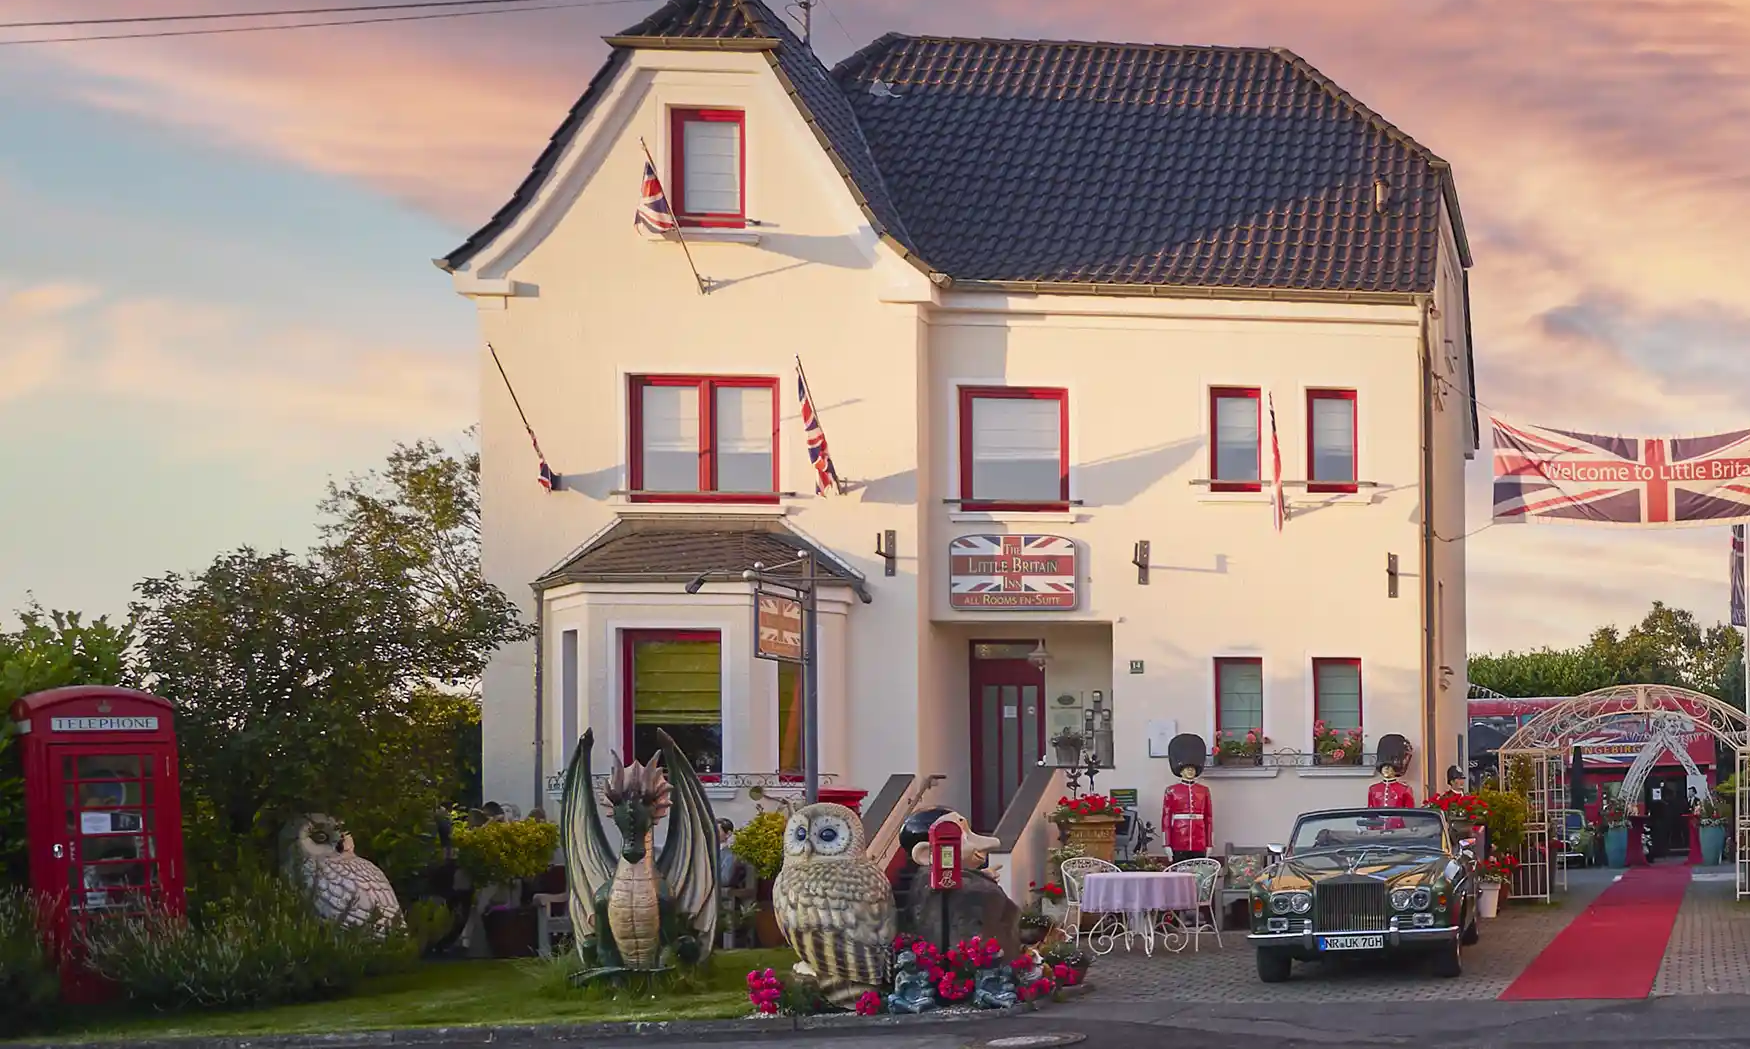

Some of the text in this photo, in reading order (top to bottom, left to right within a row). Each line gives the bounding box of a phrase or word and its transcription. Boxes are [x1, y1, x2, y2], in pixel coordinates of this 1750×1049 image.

[1543, 461, 1629, 481] Welcome
[1634, 463, 1654, 480] to
[1660, 460, 1706, 480] Little
[56, 718, 153, 729] TELEPHONE
[1326, 939, 1339, 948] NR
[1345, 938, 1358, 947] UK
